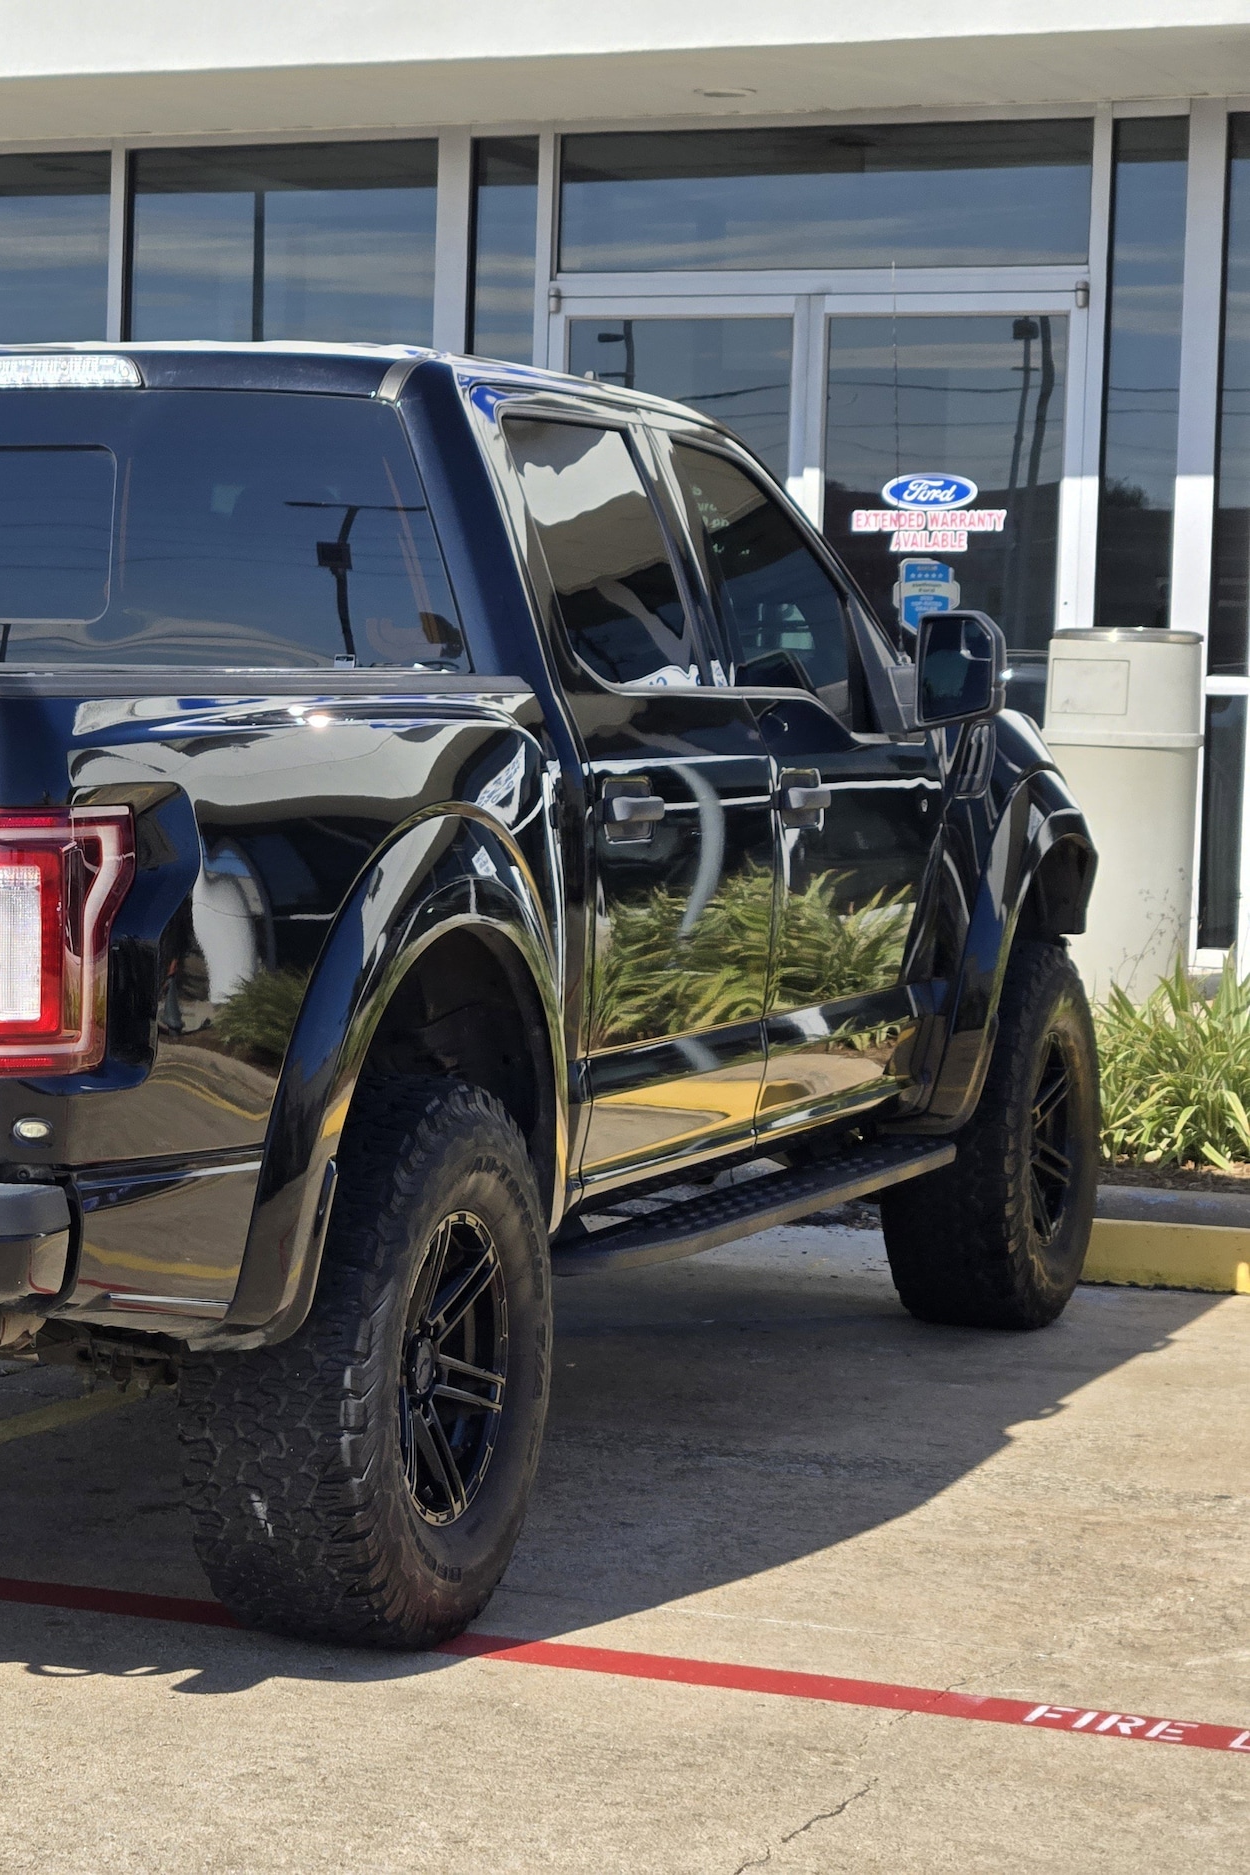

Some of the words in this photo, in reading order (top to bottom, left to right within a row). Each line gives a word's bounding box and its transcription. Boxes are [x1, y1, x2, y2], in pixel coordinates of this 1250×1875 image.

[902, 479, 957, 502] Ford
[854, 511, 925, 529] EXTENDED
[927, 511, 1006, 529] WARRANTY
[893, 532, 966, 549] AVAILABLE
[1022, 1704, 1199, 1742] FIRE
